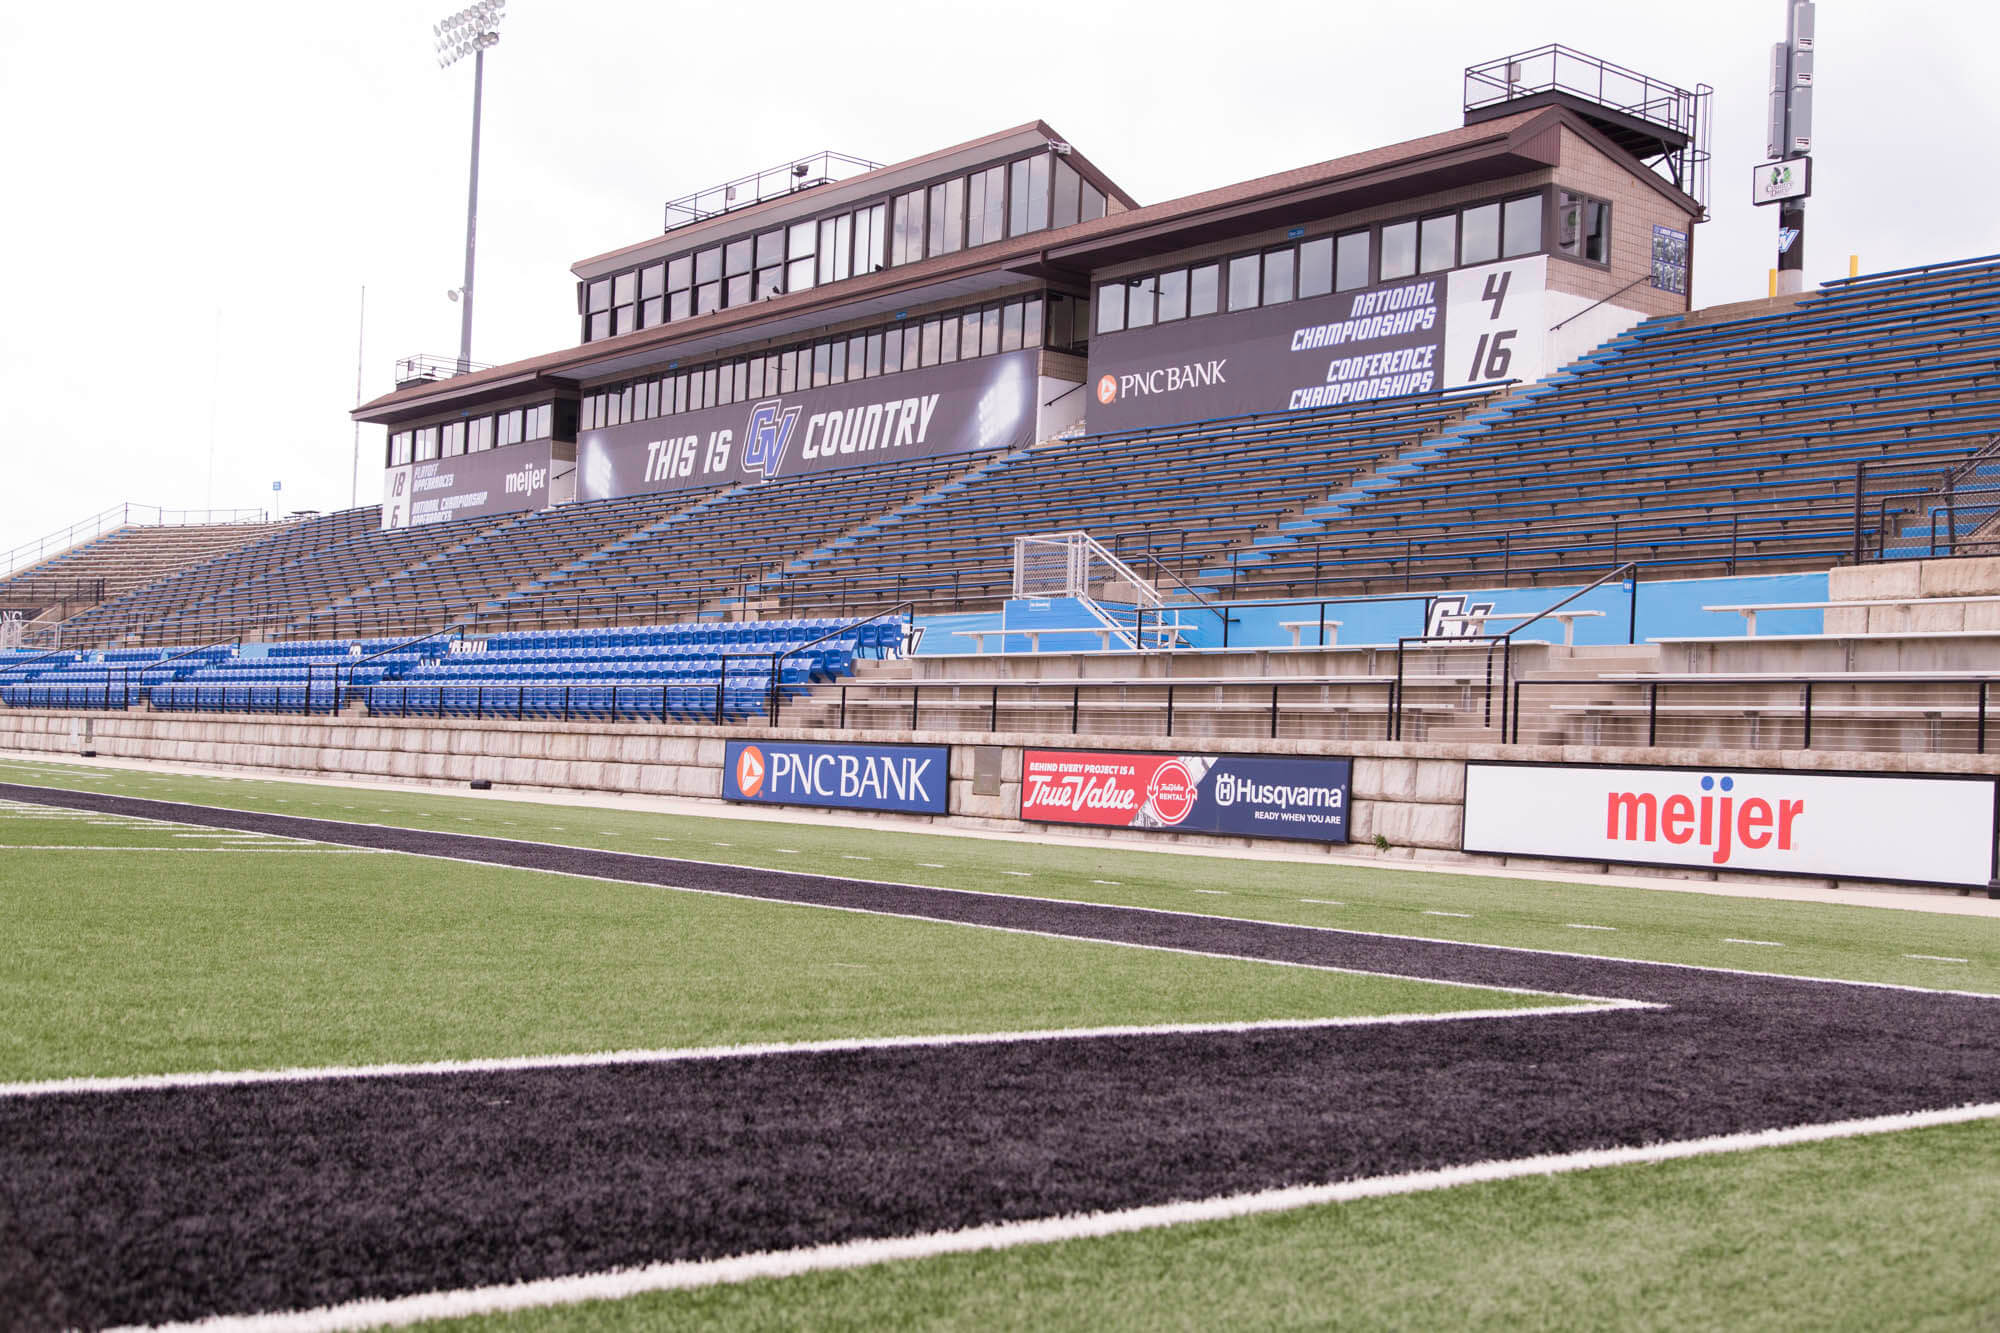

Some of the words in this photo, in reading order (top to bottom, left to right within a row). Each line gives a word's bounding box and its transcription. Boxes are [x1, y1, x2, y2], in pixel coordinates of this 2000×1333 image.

[1350, 281, 1435, 318] NATIONAL
[1481, 271, 1512, 320] 4
[1291, 306, 1437, 351] CHAMPIONSHIPS
[1326, 344, 1437, 383] CONFERENCE
[1468, 329, 1518, 382] 16
[1288, 370, 1434, 411] CHAMPIONSHIPS
[644, 435, 698, 482] THIS
[703, 429, 732, 474] IS
[802, 394, 940, 459] COUNTRY
[391, 471, 406, 497] 18
[505, 463, 547, 497] meijer
[1029, 761, 1058, 772] BEHIND
[1058, 763, 1083, 773] EVERY
[1084, 764, 1119, 775] PROJECT
[1120, 765, 1128, 775] IS
[1128, 765, 1135, 775] A
[1236, 778, 1342, 809] Husqvarna
[1254, 810, 1280, 821] READY
[1281, 812, 1306, 823] WHEN
[1307, 814, 1324, 824] YOU
[1325, 815, 1342, 825] ARE
[1606, 775, 1804, 864] meijer
